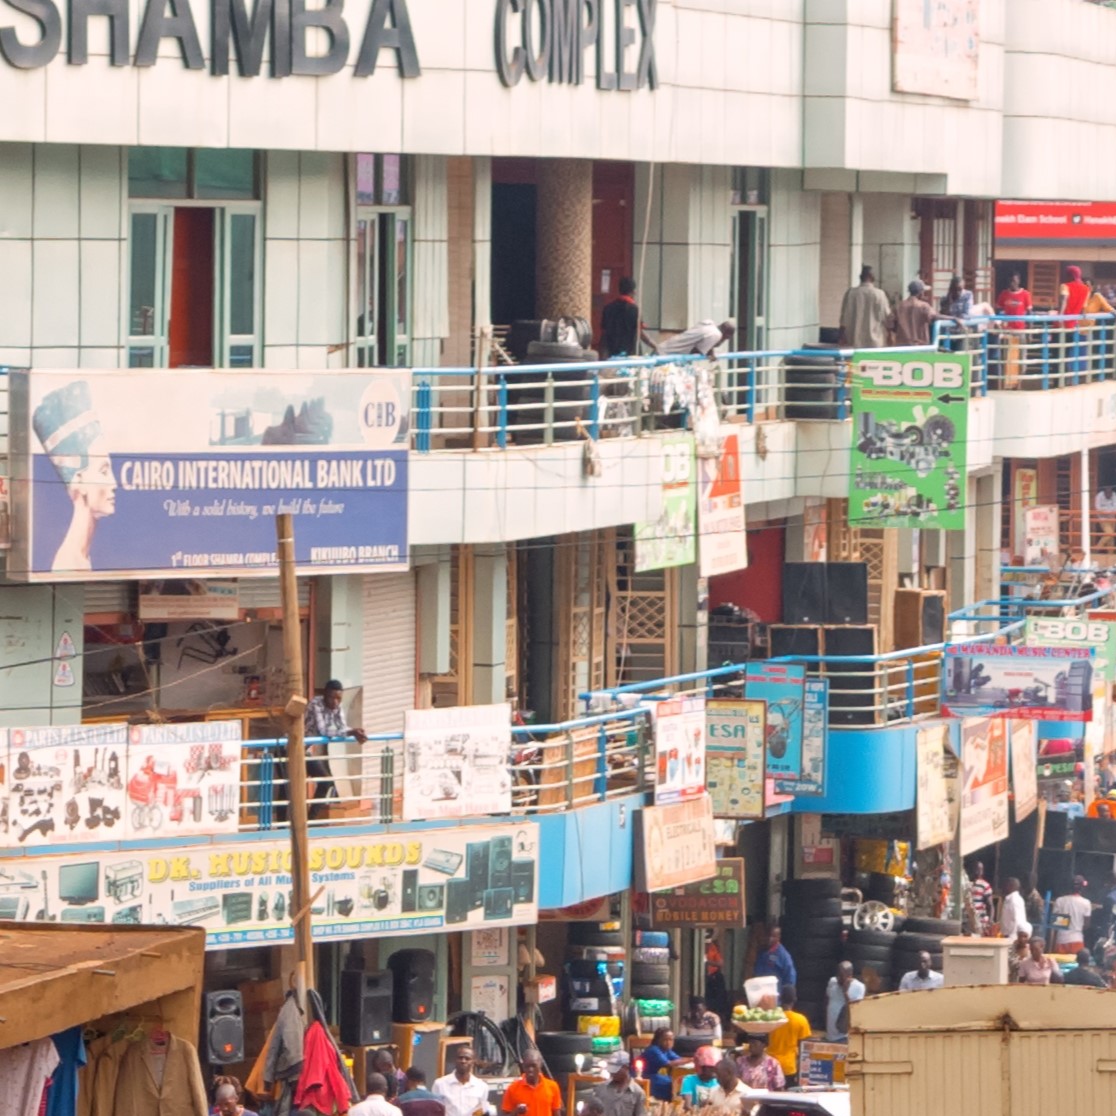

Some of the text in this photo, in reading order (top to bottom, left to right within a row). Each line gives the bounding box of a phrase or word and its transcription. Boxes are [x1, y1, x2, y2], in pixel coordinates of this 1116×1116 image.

[0, 0, 659, 91] SHAMBA COMPLEX
[867, 360, 963, 388] BOB
[121, 458, 396, 490] CAIRO INTERNATIONAL BANK LTD
[193, 504, 200, 516] a
[202, 499, 225, 516] solid
[277, 498, 300, 515] build
[302, 498, 316, 515] the
[317, 498, 344, 518] future
[245, 551, 279, 566] COMPLE
[358, 545, 399, 562] BRANCH
[1044, 621, 1110, 642] BOB
[1017, 646, 1047, 657] MUSIC
[1050, 647, 1090, 658] CENTER
[309, 841, 423, 870] SOUNDS
[189, 879, 241, 892] Suppliers
[244, 877, 256, 888] of
[258, 876, 273, 887] All
[312, 871, 356, 884] Systems
[655, 910, 739, 921] MOBILE MONEY
